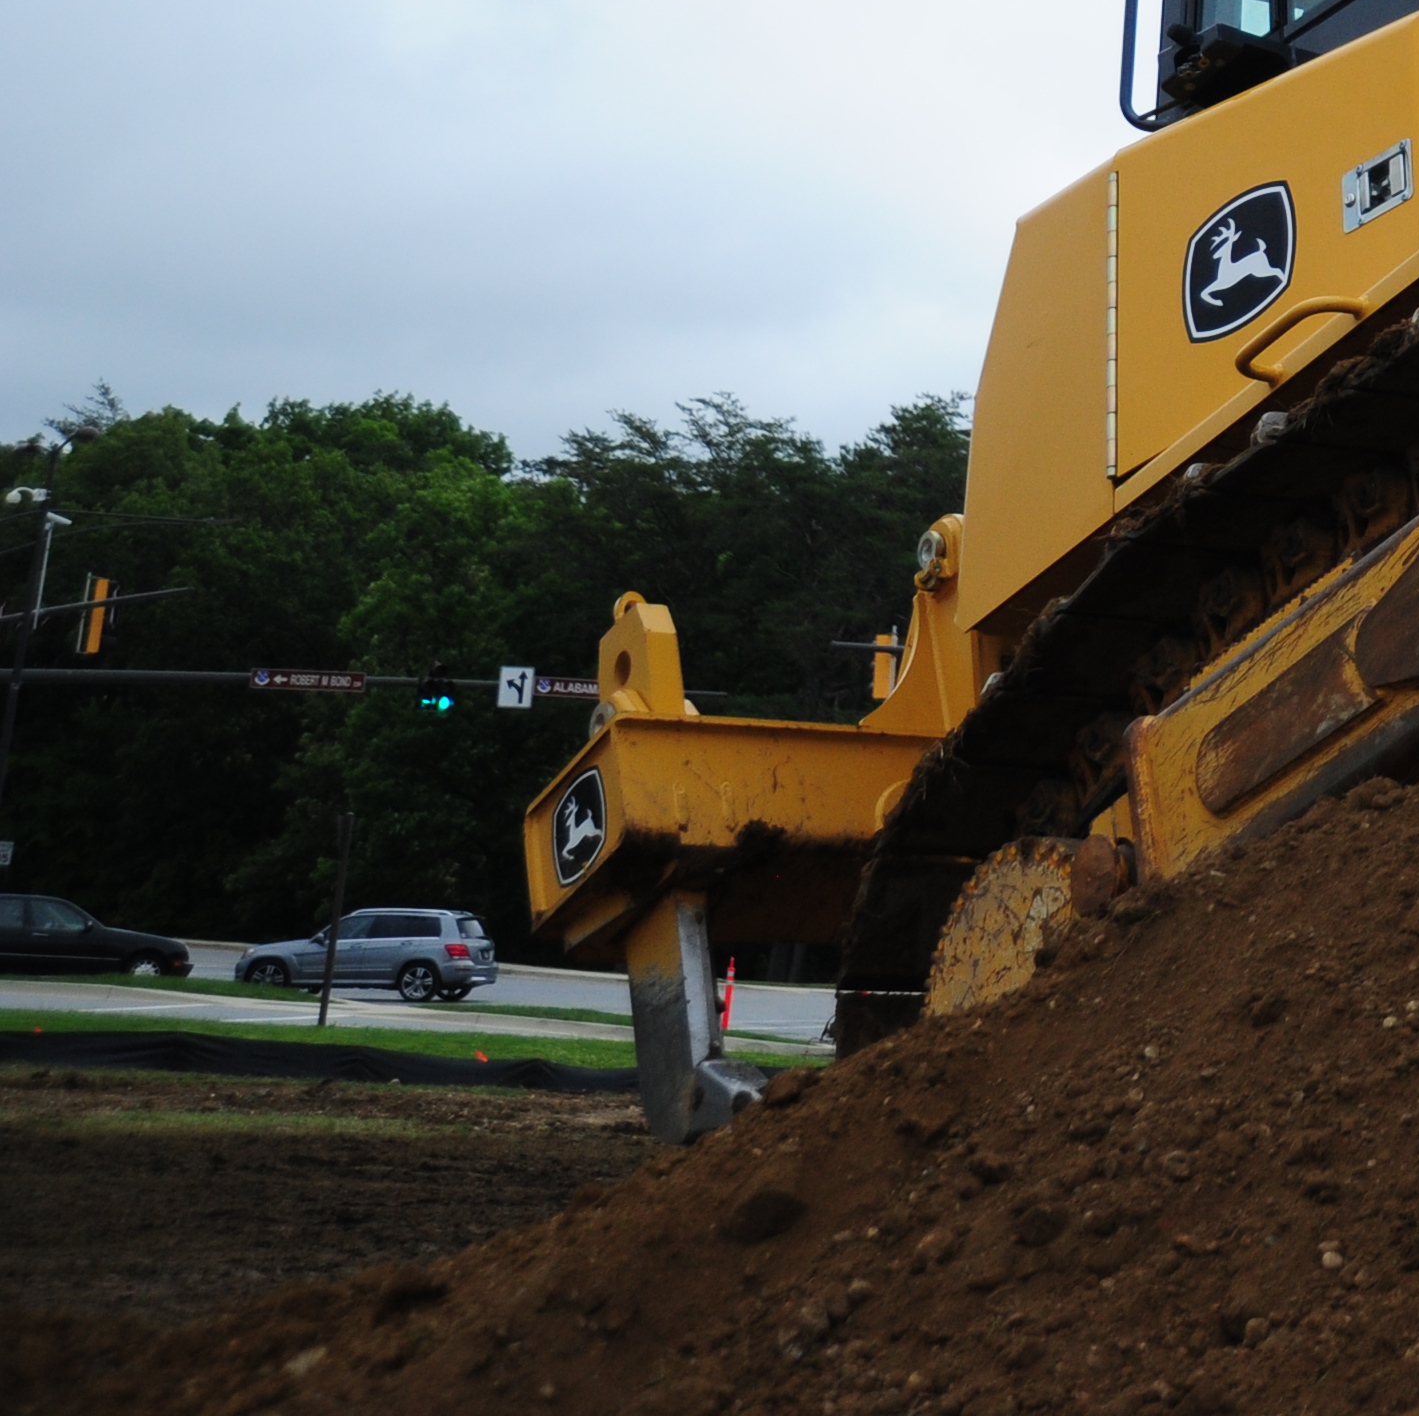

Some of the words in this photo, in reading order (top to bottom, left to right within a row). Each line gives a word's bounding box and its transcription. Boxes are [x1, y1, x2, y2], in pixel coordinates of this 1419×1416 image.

[289, 674, 320, 686] ROBERT
[330, 675, 352, 687] BOND
[553, 681, 599, 694] ALABAM
